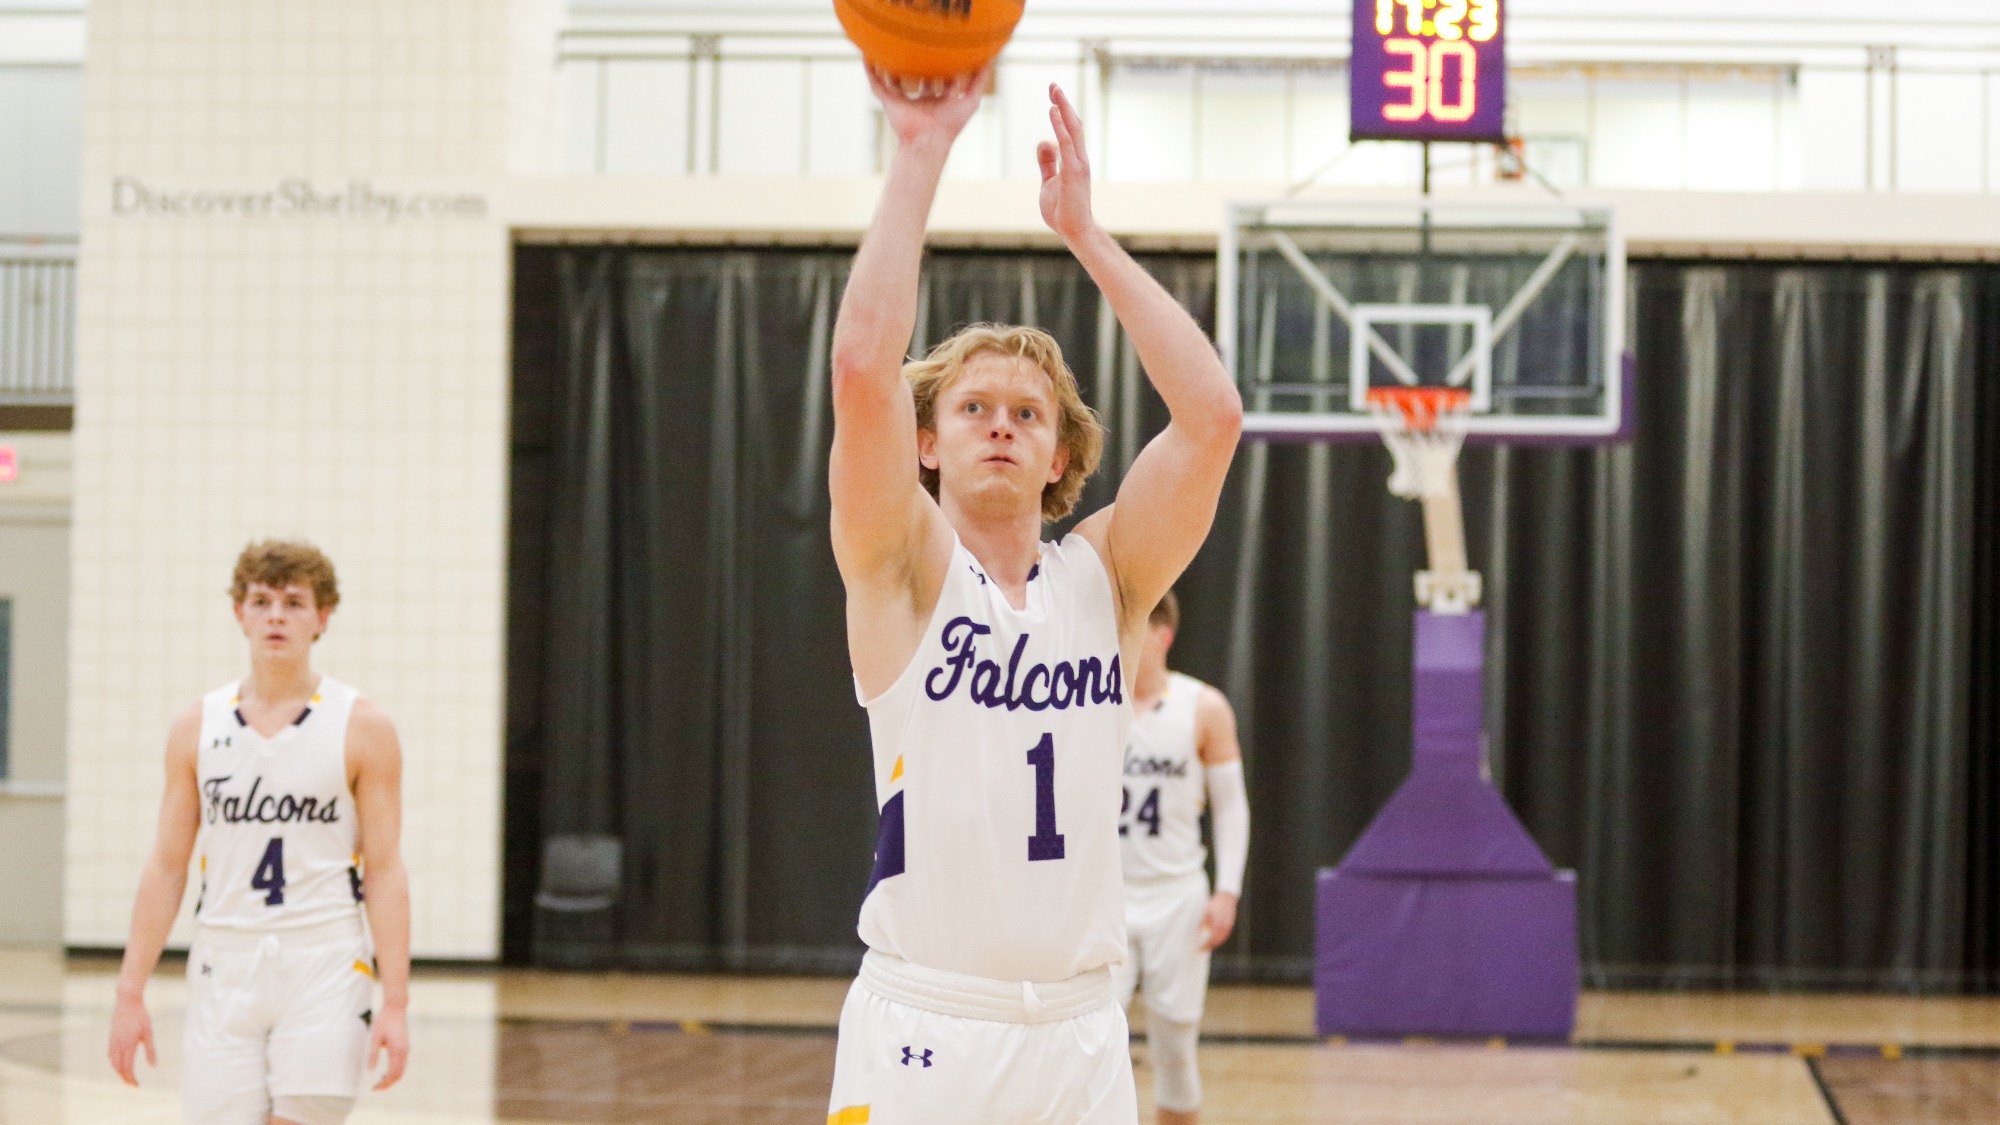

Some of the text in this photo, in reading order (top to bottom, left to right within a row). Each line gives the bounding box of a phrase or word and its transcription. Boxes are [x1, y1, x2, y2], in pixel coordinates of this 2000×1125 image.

[1382, 38, 1477, 122] 30
[110, 174, 490, 224] DiscoverShelby.com
[925, 616, 1123, 711] Falcons
[1122, 743, 1188, 779] lcons
[203, 775, 341, 826] Falcons
[1027, 732, 1065, 861] 1
[251, 837, 286, 906] 4
